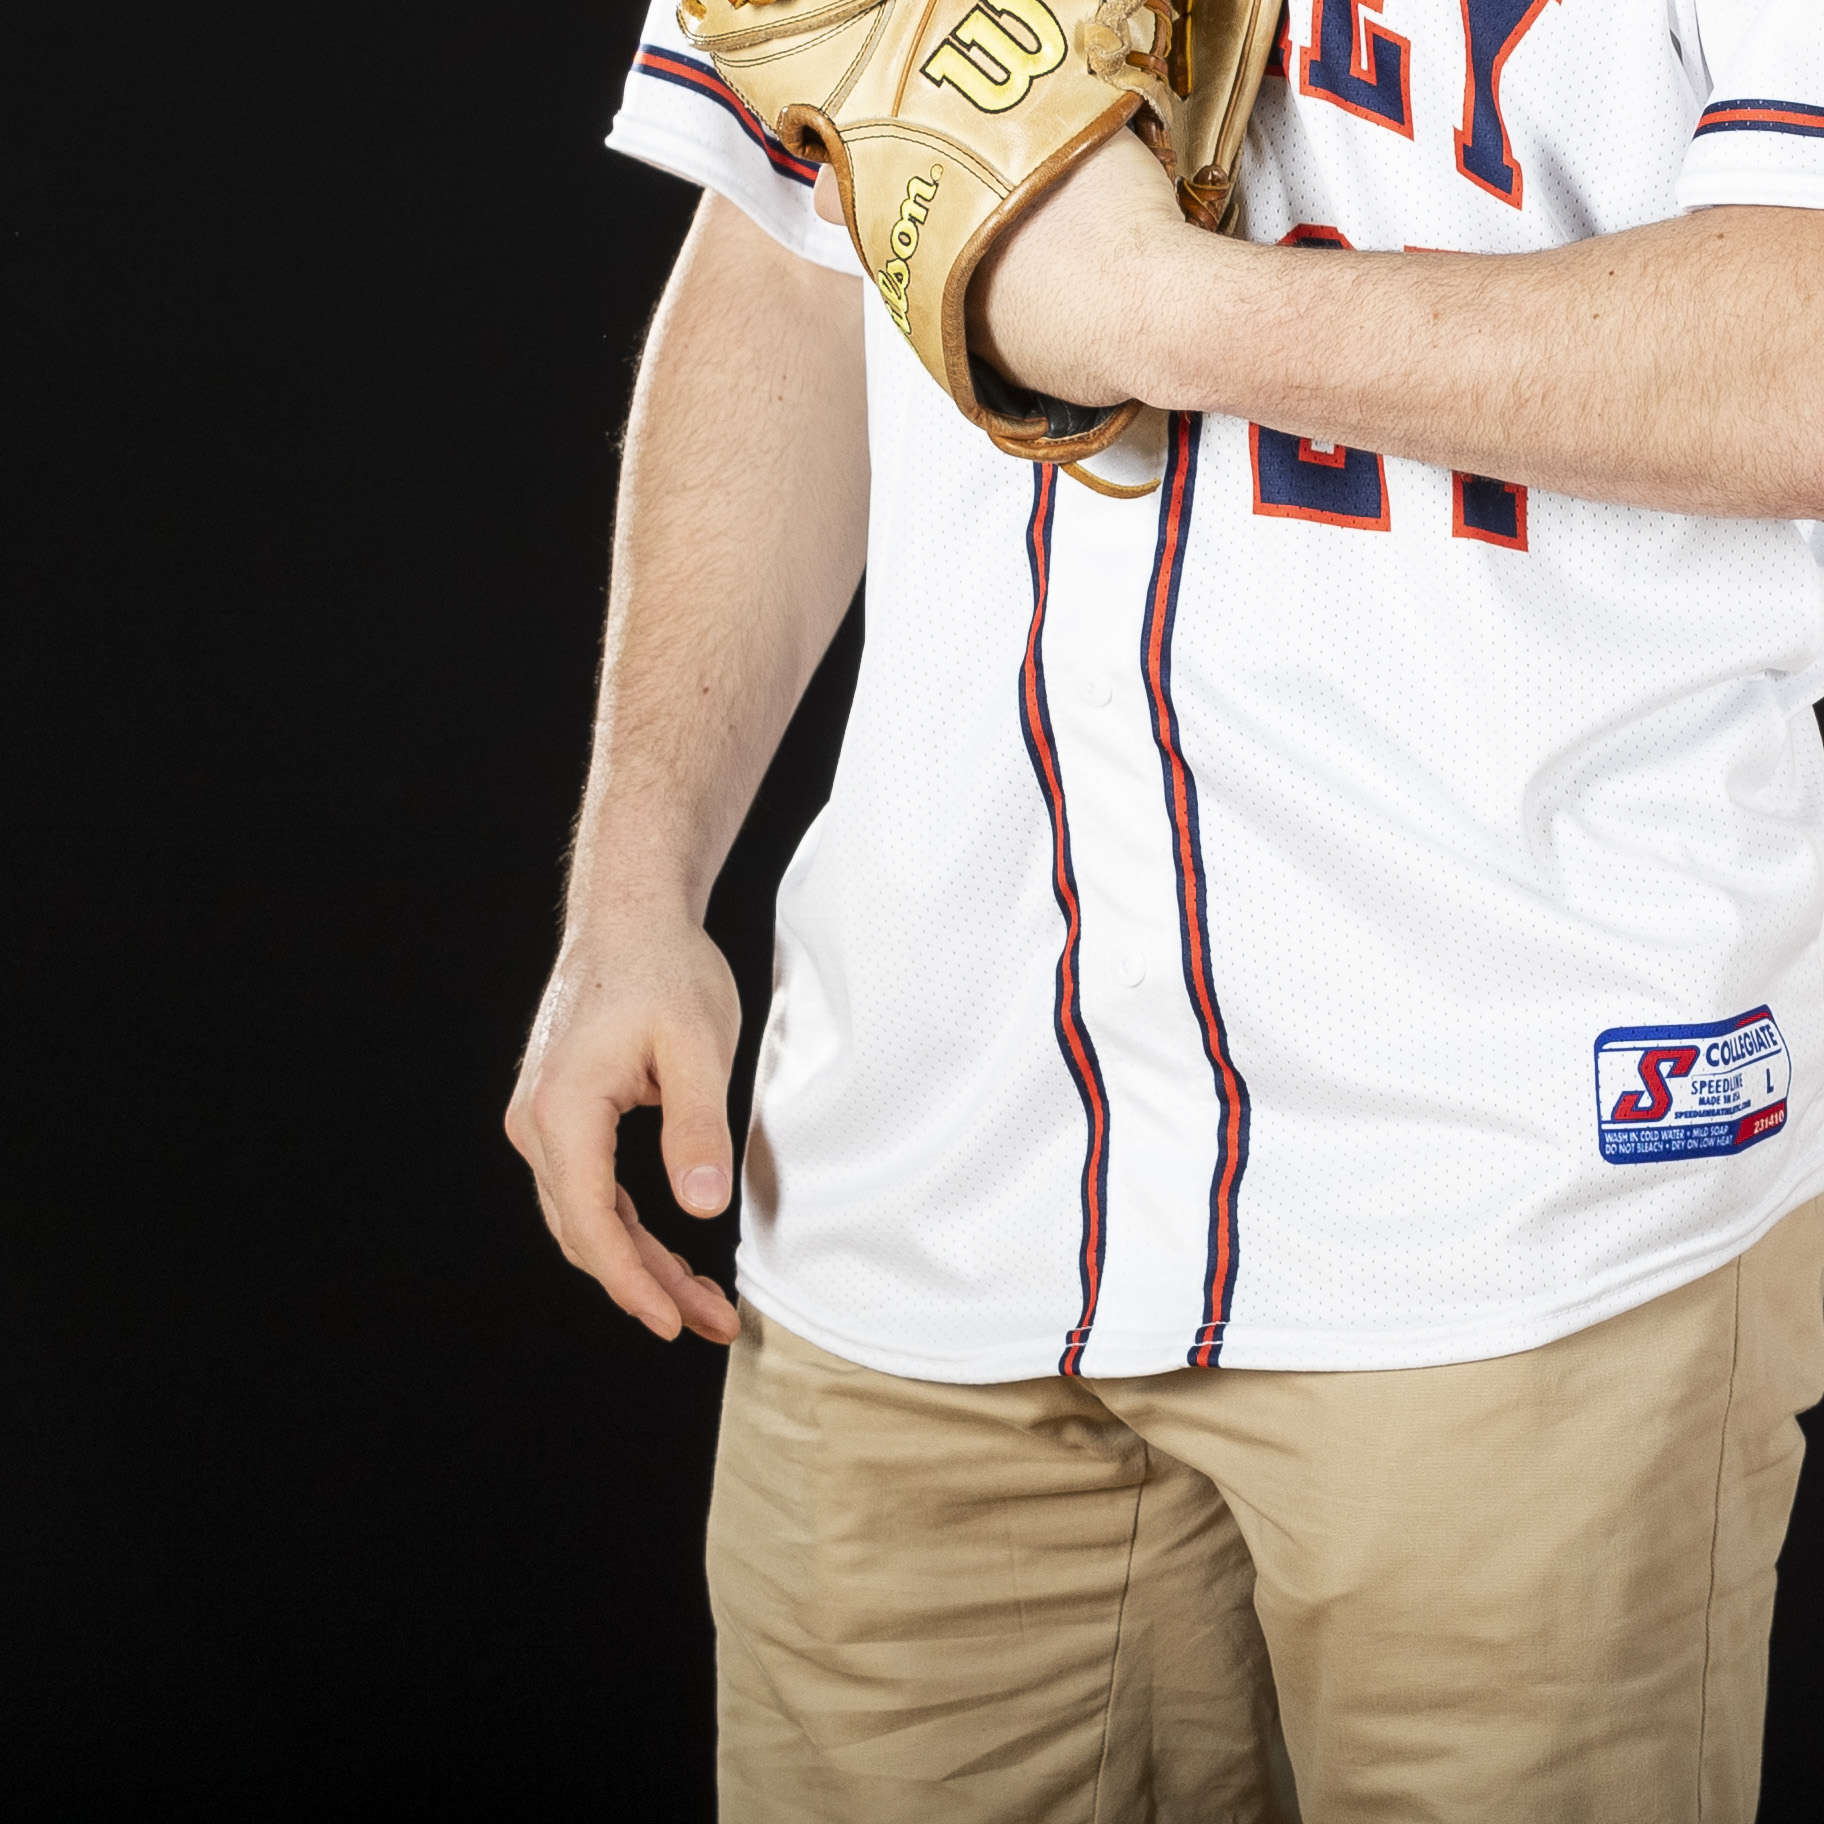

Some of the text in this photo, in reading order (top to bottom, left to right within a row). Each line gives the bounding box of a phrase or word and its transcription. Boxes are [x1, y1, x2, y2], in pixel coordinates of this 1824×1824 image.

[1705, 1024, 1779, 1067] COLLEGIATE
[1690, 1072, 1744, 1096] SPEEDLINE
[1765, 1068, 1774, 1095] L
[1698, 1095, 1721, 1106] MADE
[1604, 1124, 1729, 1143] WASH IN COLD WATER MILD SOAP
[1753, 1109, 1785, 1135] 231410
[1605, 1135, 1733, 1155] DO NOT BLEACH DRY ON LOW HEAT
